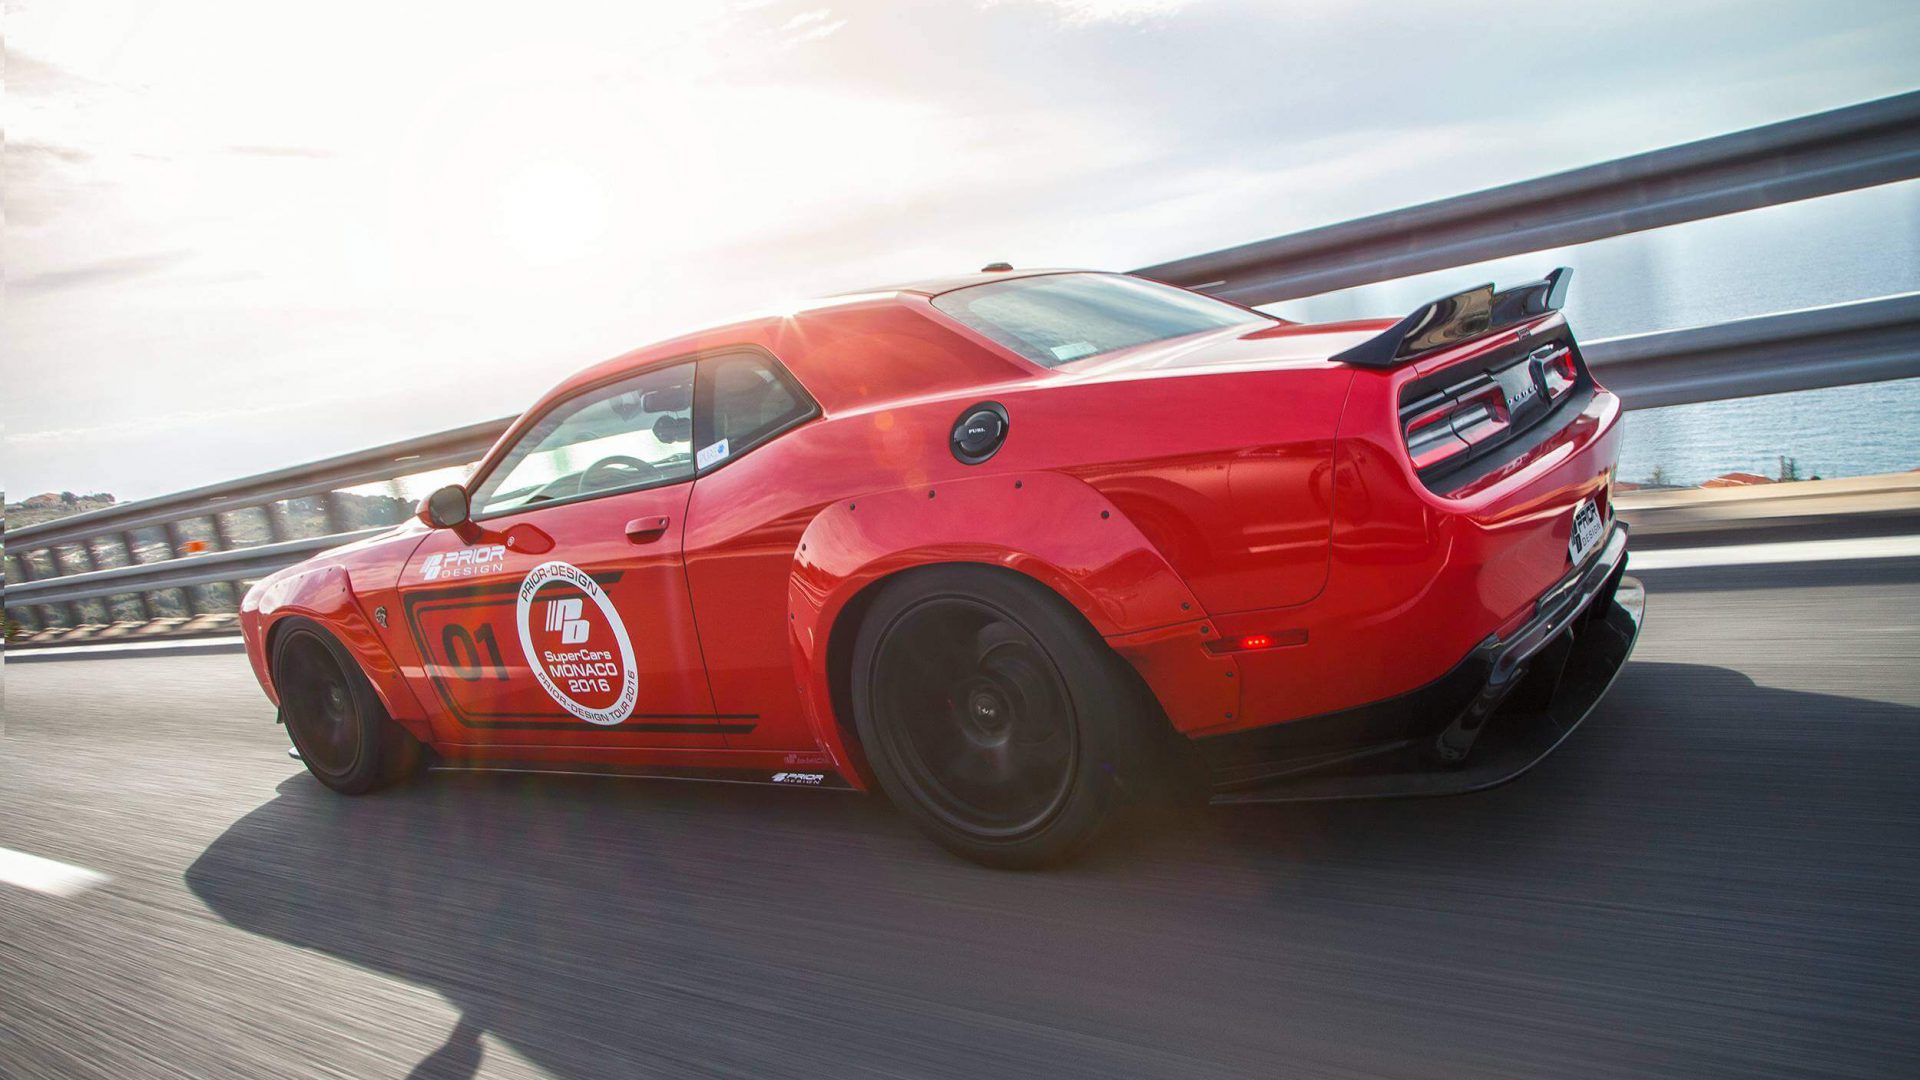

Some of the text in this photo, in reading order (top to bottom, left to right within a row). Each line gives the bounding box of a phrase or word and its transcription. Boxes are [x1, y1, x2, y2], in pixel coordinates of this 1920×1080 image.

[443, 545, 506, 568] PRIOR
[442, 563, 503, 578] DESIGN
[521, 565, 598, 602] PRIOR-DESIGN
[442, 623, 510, 681] 01
[544, 649, 612, 664] SuperCars
[549, 662, 618, 677] MONACO
[568, 679, 611, 693] 2016
[538, 670, 635, 722] PRIOR-DESIGN TOUR 2016
[786, 773, 824, 781] PRIOR
